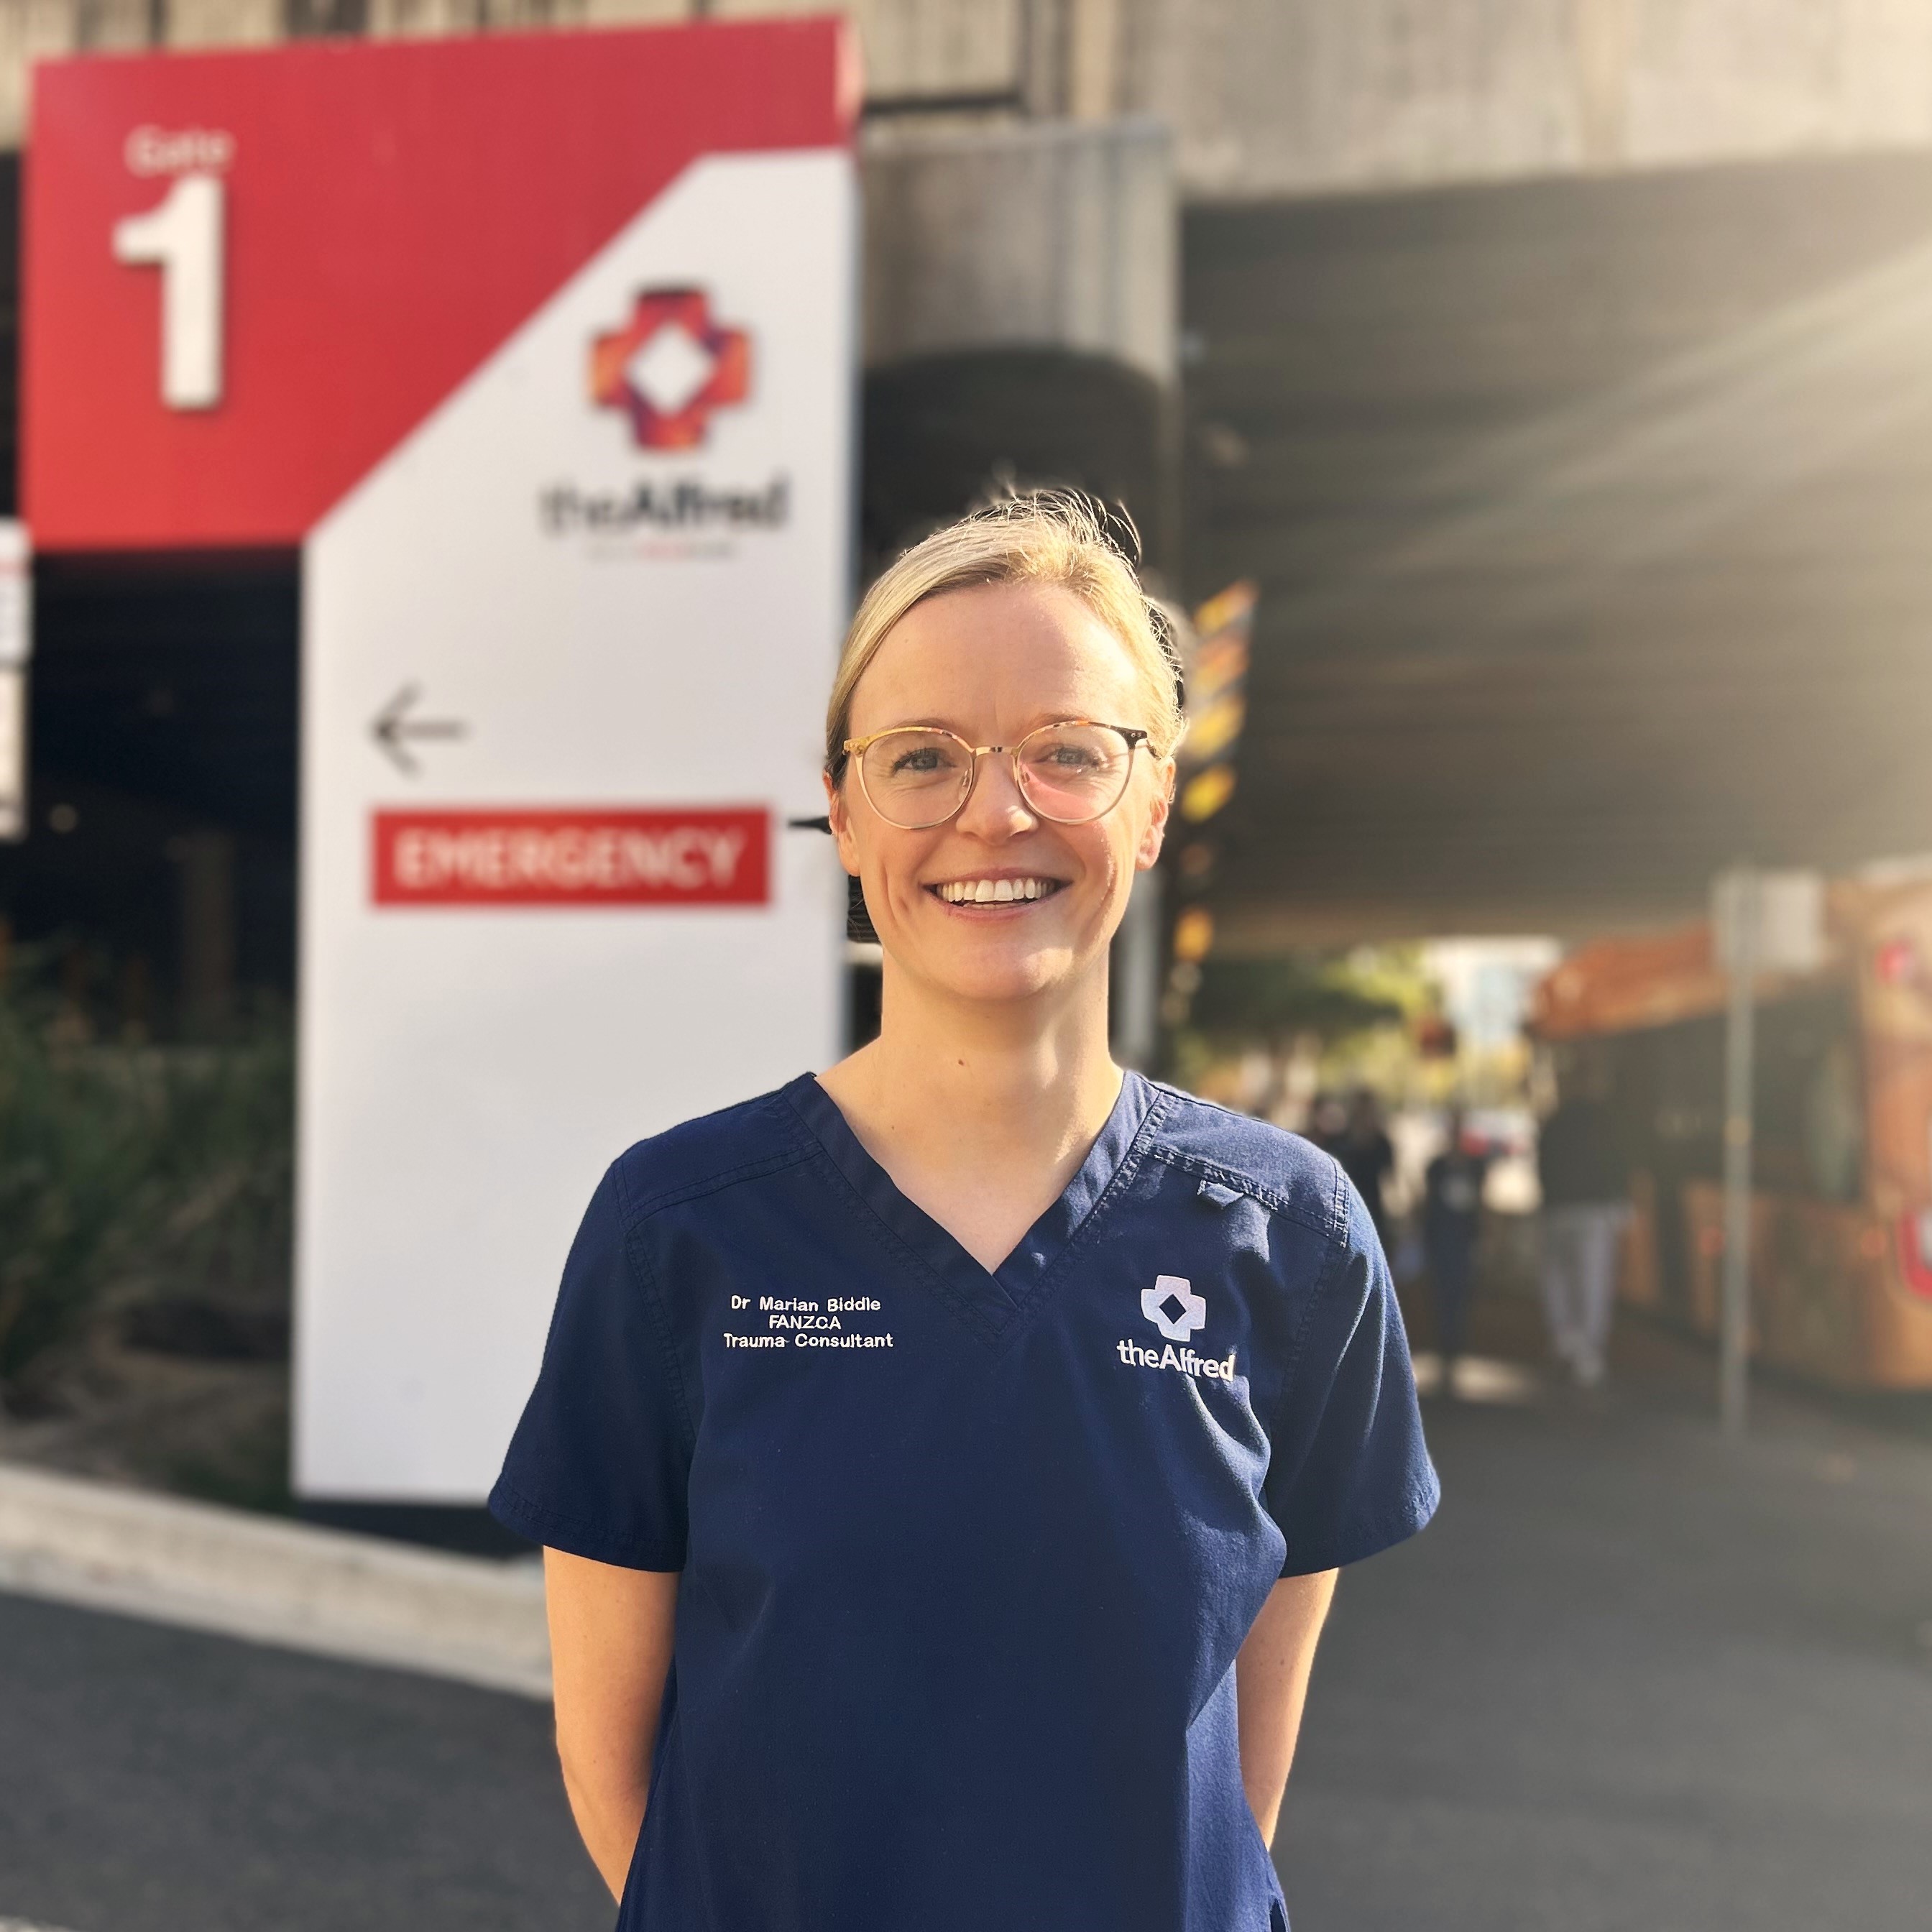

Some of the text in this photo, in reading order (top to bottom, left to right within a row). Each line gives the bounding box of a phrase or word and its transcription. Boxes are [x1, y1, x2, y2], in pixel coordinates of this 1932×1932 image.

[114, 175, 225, 410] 1
[393, 827, 745, 889] EMERGENCY
[730, 1294, 881, 1312] Dr Marian Biddle
[768, 1314, 842, 1330] FANZCA
[723, 1333, 893, 1348] Trauma Consultant
[1116, 1338, 1236, 1382] theAlfred
